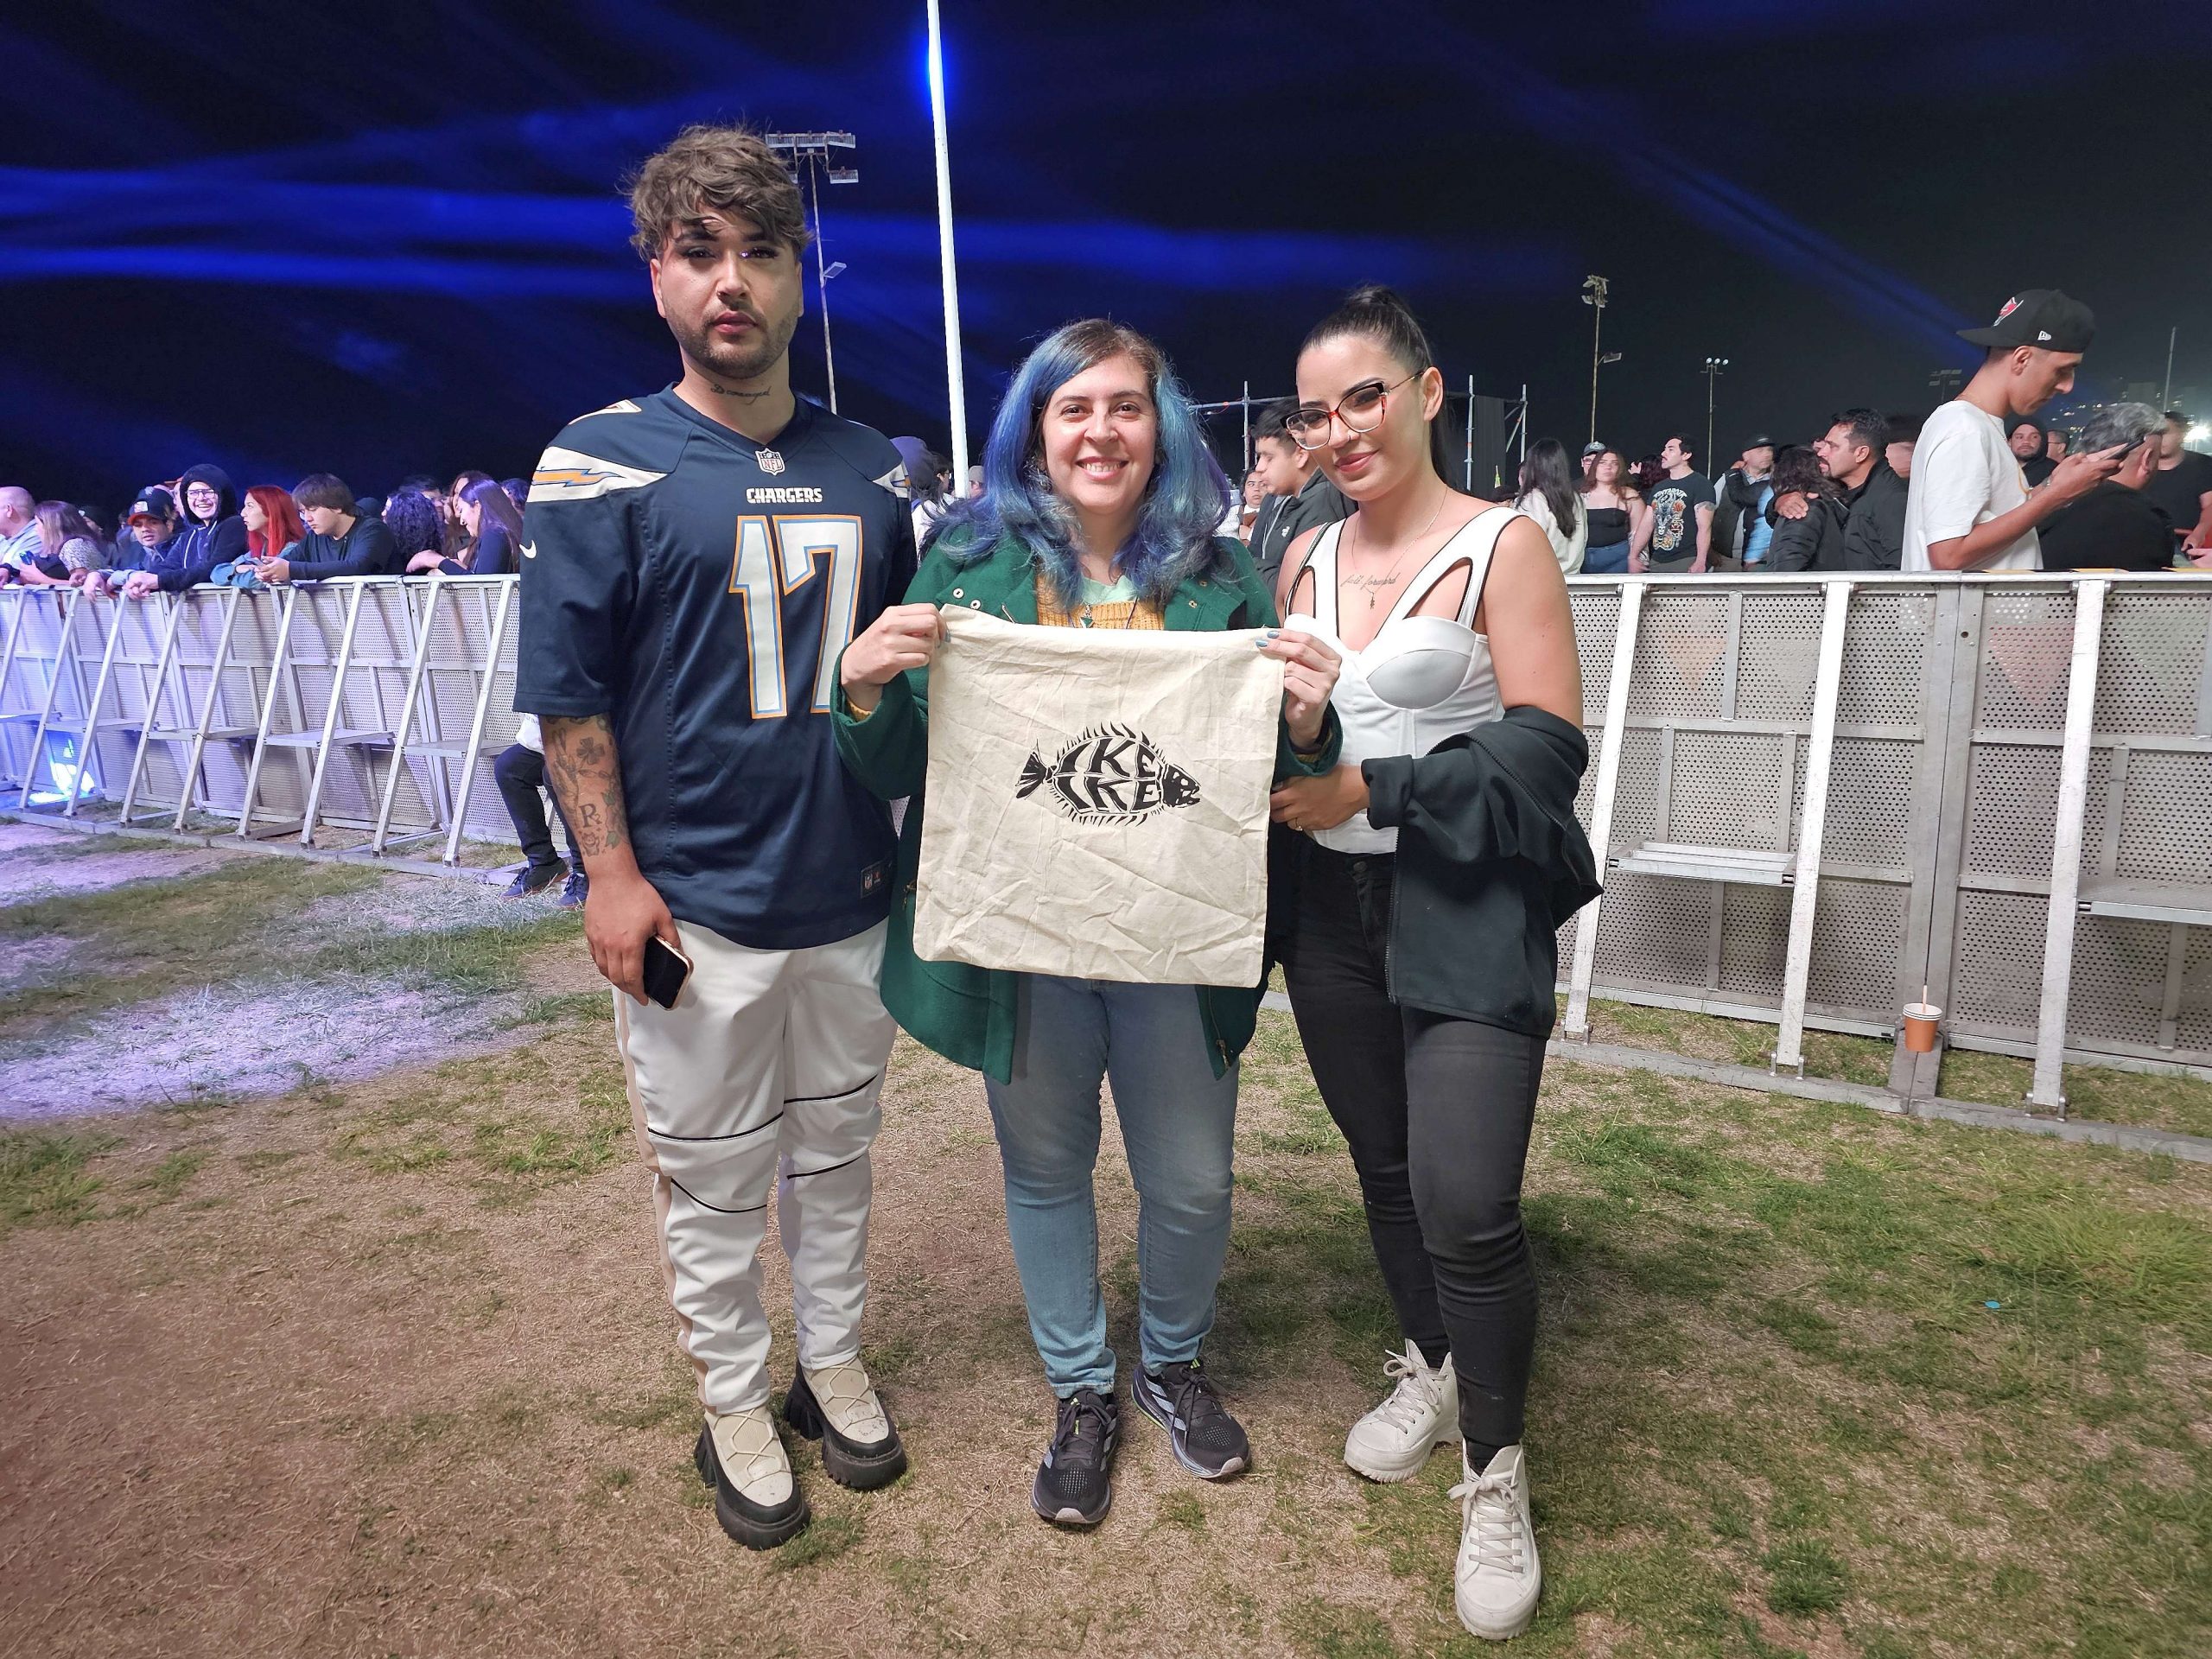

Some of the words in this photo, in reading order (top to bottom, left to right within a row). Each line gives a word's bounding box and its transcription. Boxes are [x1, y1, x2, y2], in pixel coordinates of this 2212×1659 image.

[762, 459, 783, 469] NFL
[746, 487, 823, 504] CHARGERS
[728, 514, 862, 719] 17
